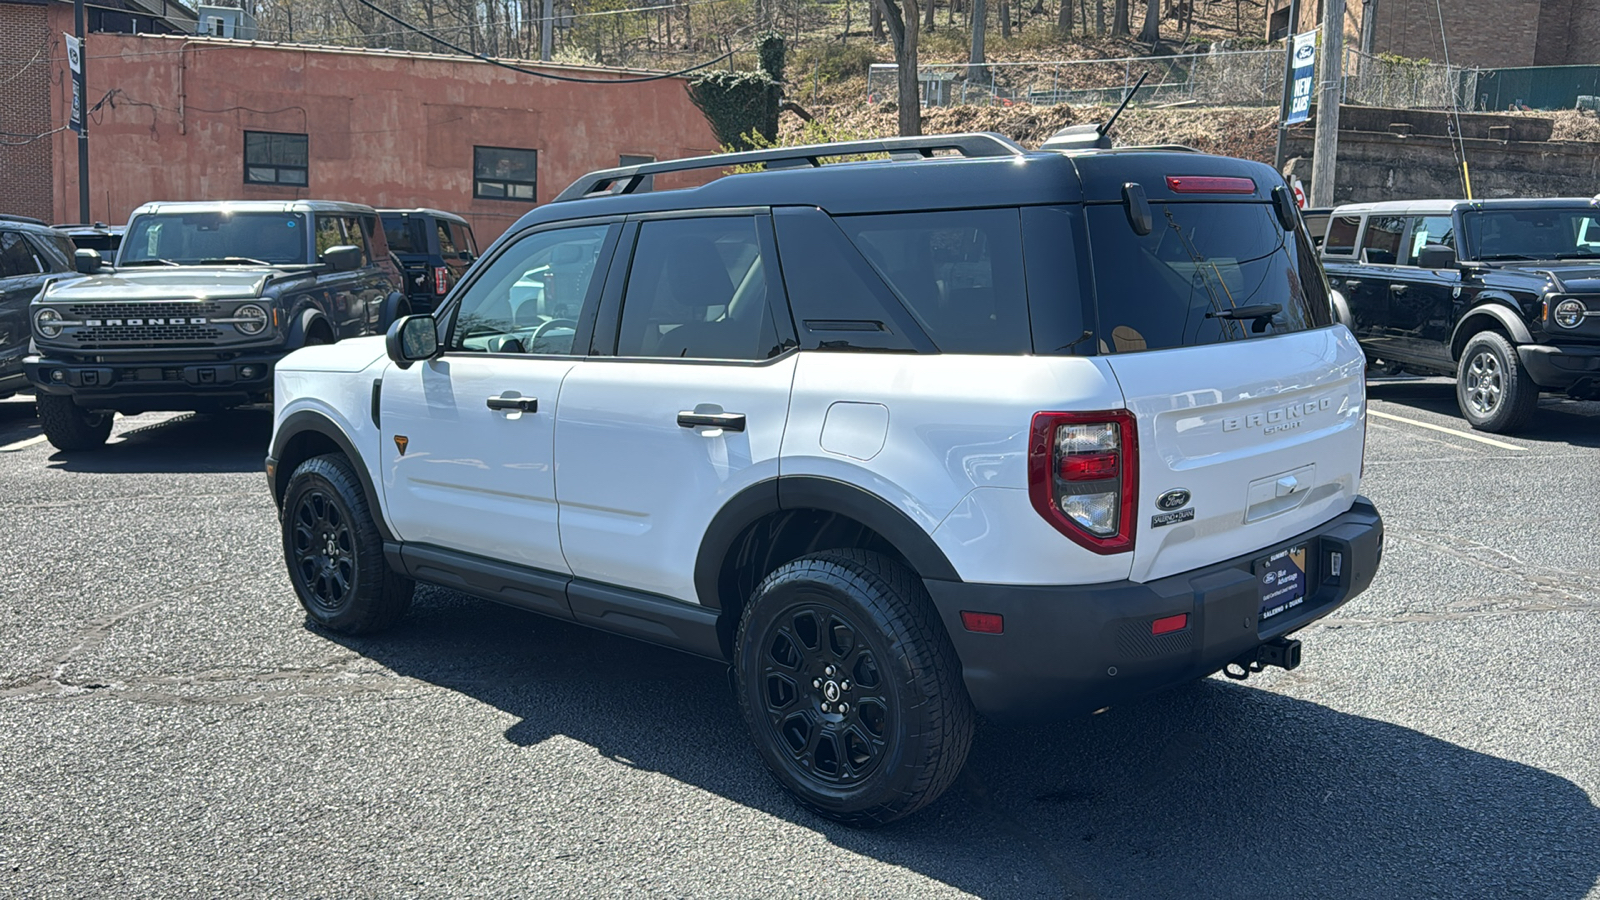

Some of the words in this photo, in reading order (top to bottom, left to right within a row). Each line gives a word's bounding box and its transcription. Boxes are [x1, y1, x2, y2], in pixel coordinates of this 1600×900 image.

[1294, 76, 1312, 97] NEW
[1292, 96, 1309, 113] CARS
[86, 318, 207, 327] BRONCO
[1222, 398, 1331, 432] BRONCO
[1263, 419, 1304, 435] SPORT
[1153, 513, 1176, 524] SALERNO
[1178, 509, 1194, 519] DUANE
[1277, 569, 1287, 578] Blue
[1277, 573, 1297, 585] Advantage
[1263, 605, 1284, 618] SALERNO
[1289, 597, 1303, 607] DUANE
